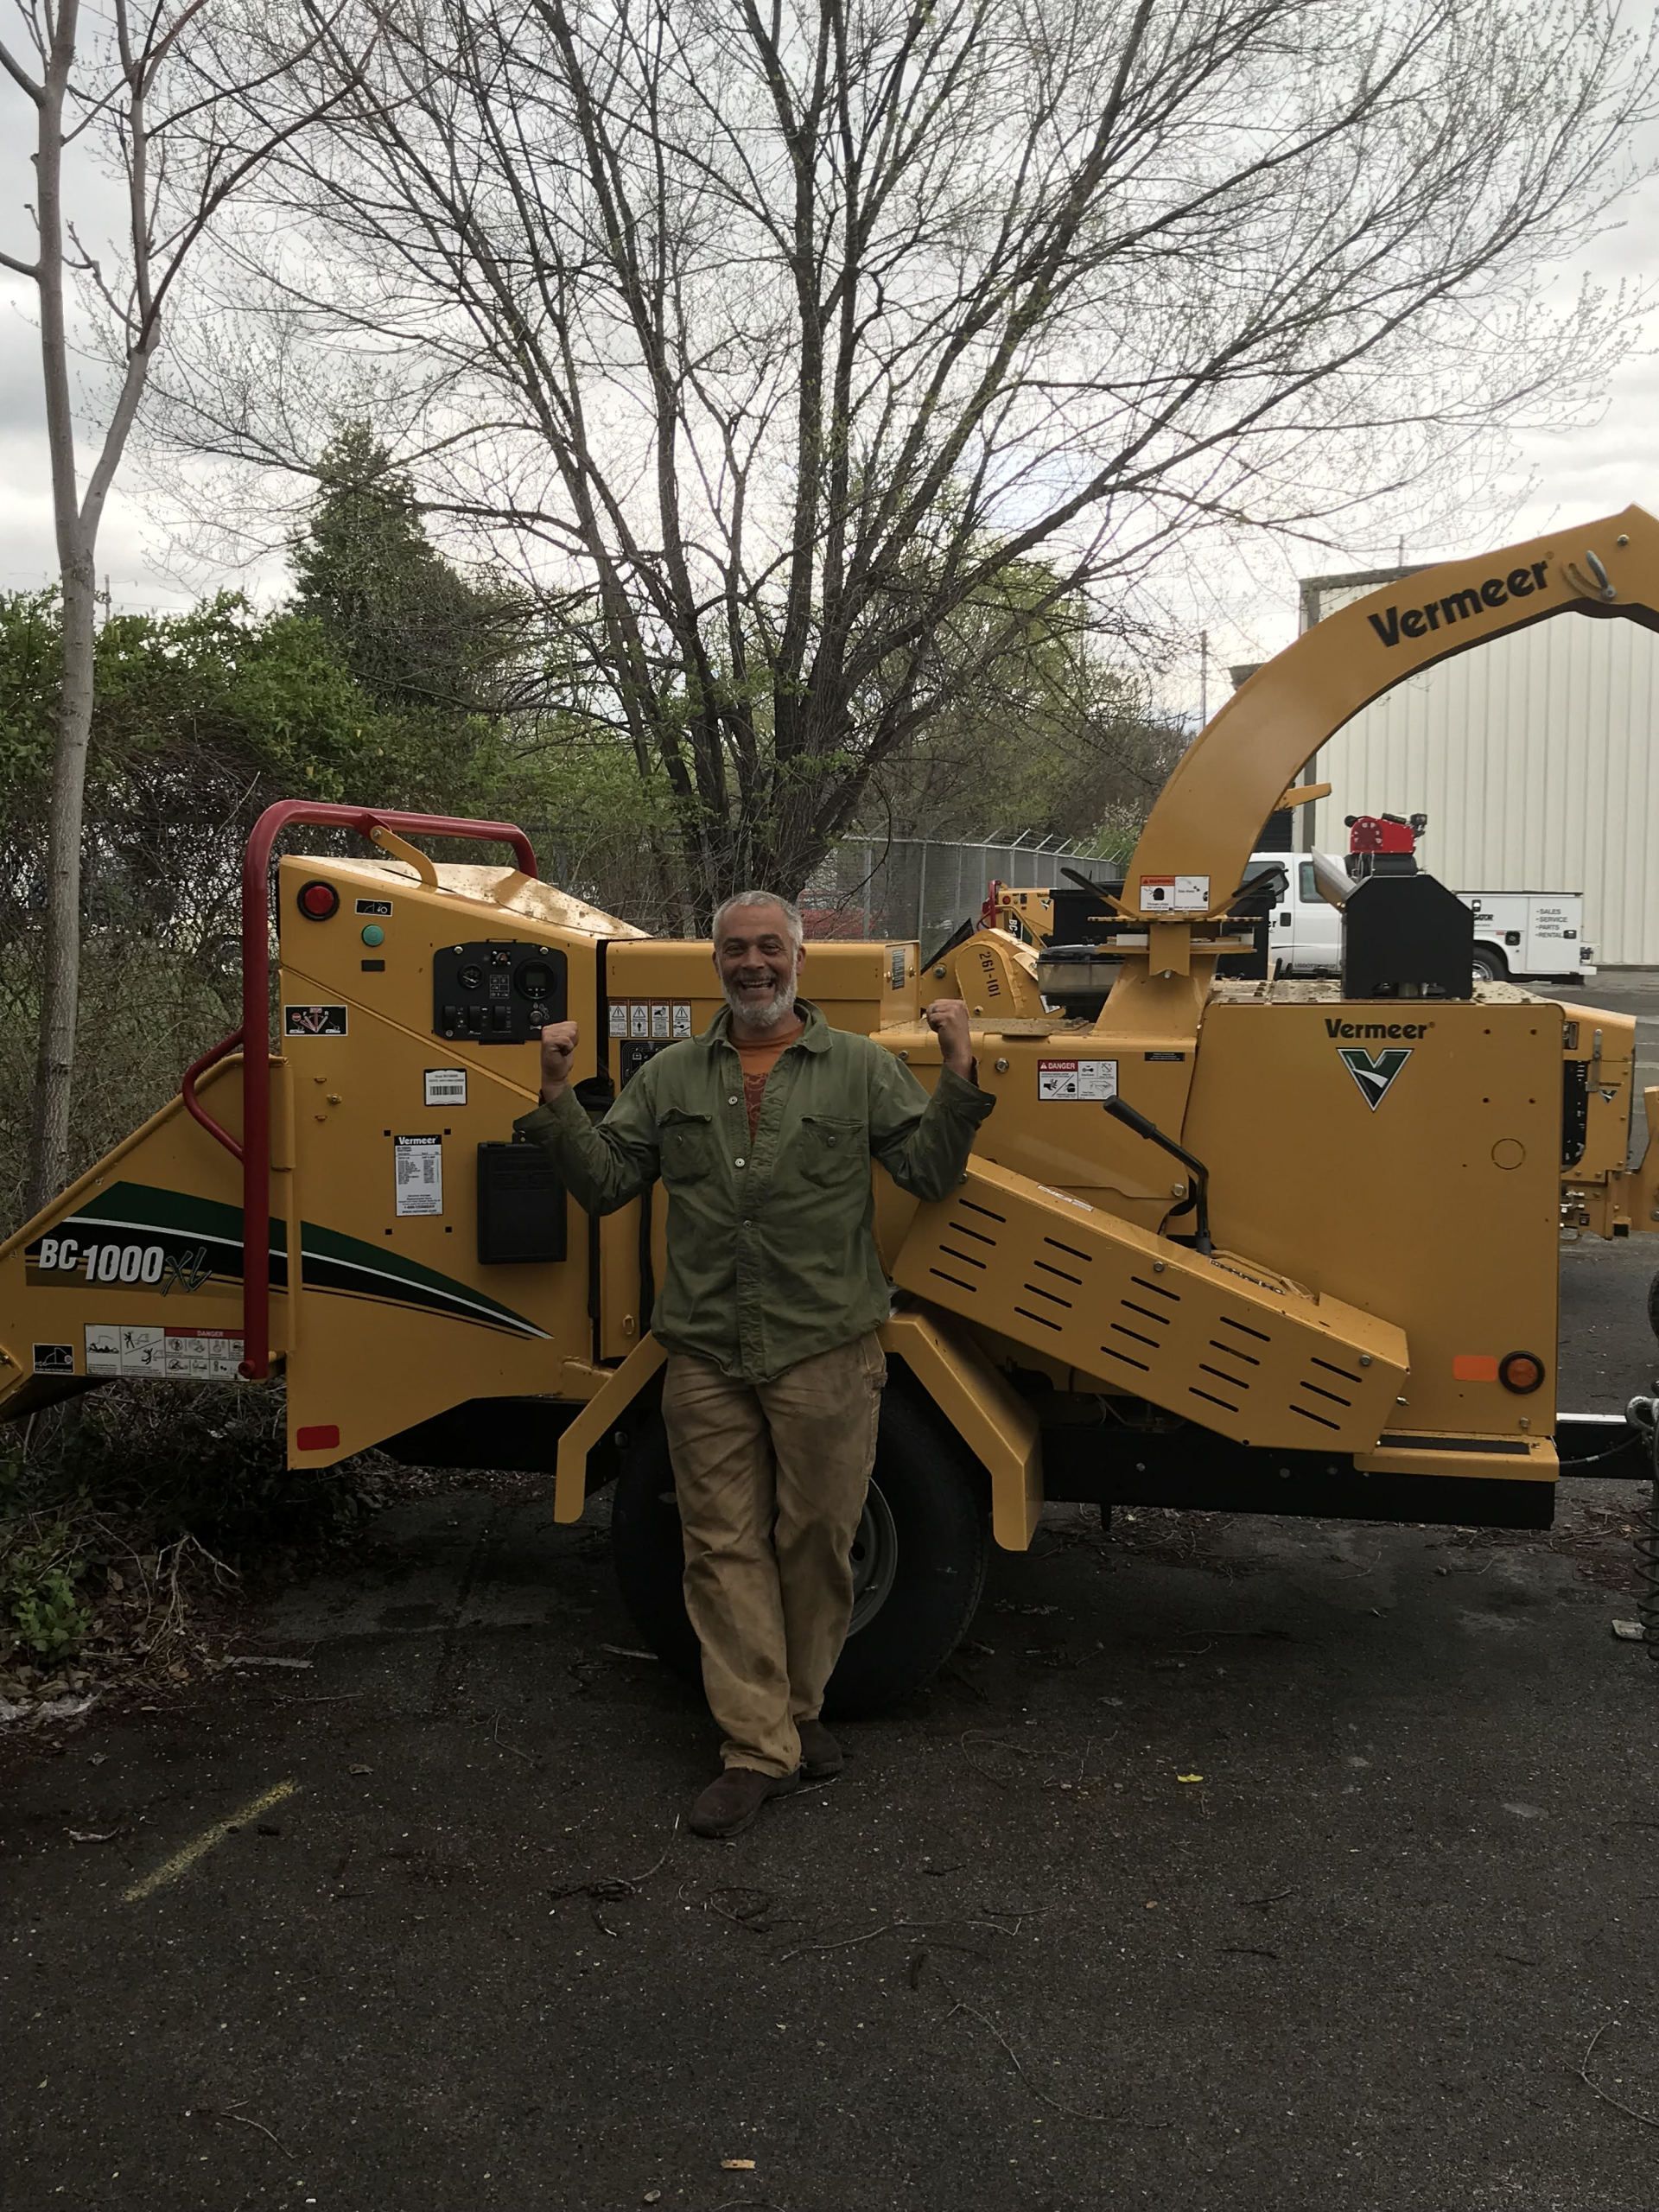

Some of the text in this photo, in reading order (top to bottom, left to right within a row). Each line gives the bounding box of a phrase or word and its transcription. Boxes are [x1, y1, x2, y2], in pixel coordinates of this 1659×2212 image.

[1367, 560, 1548, 647] Vermeer
[979, 951, 1001, 997] 261-101
[1325, 1018, 1427, 1039] Vermeer
[398, 1136, 436, 1145] Vermeer
